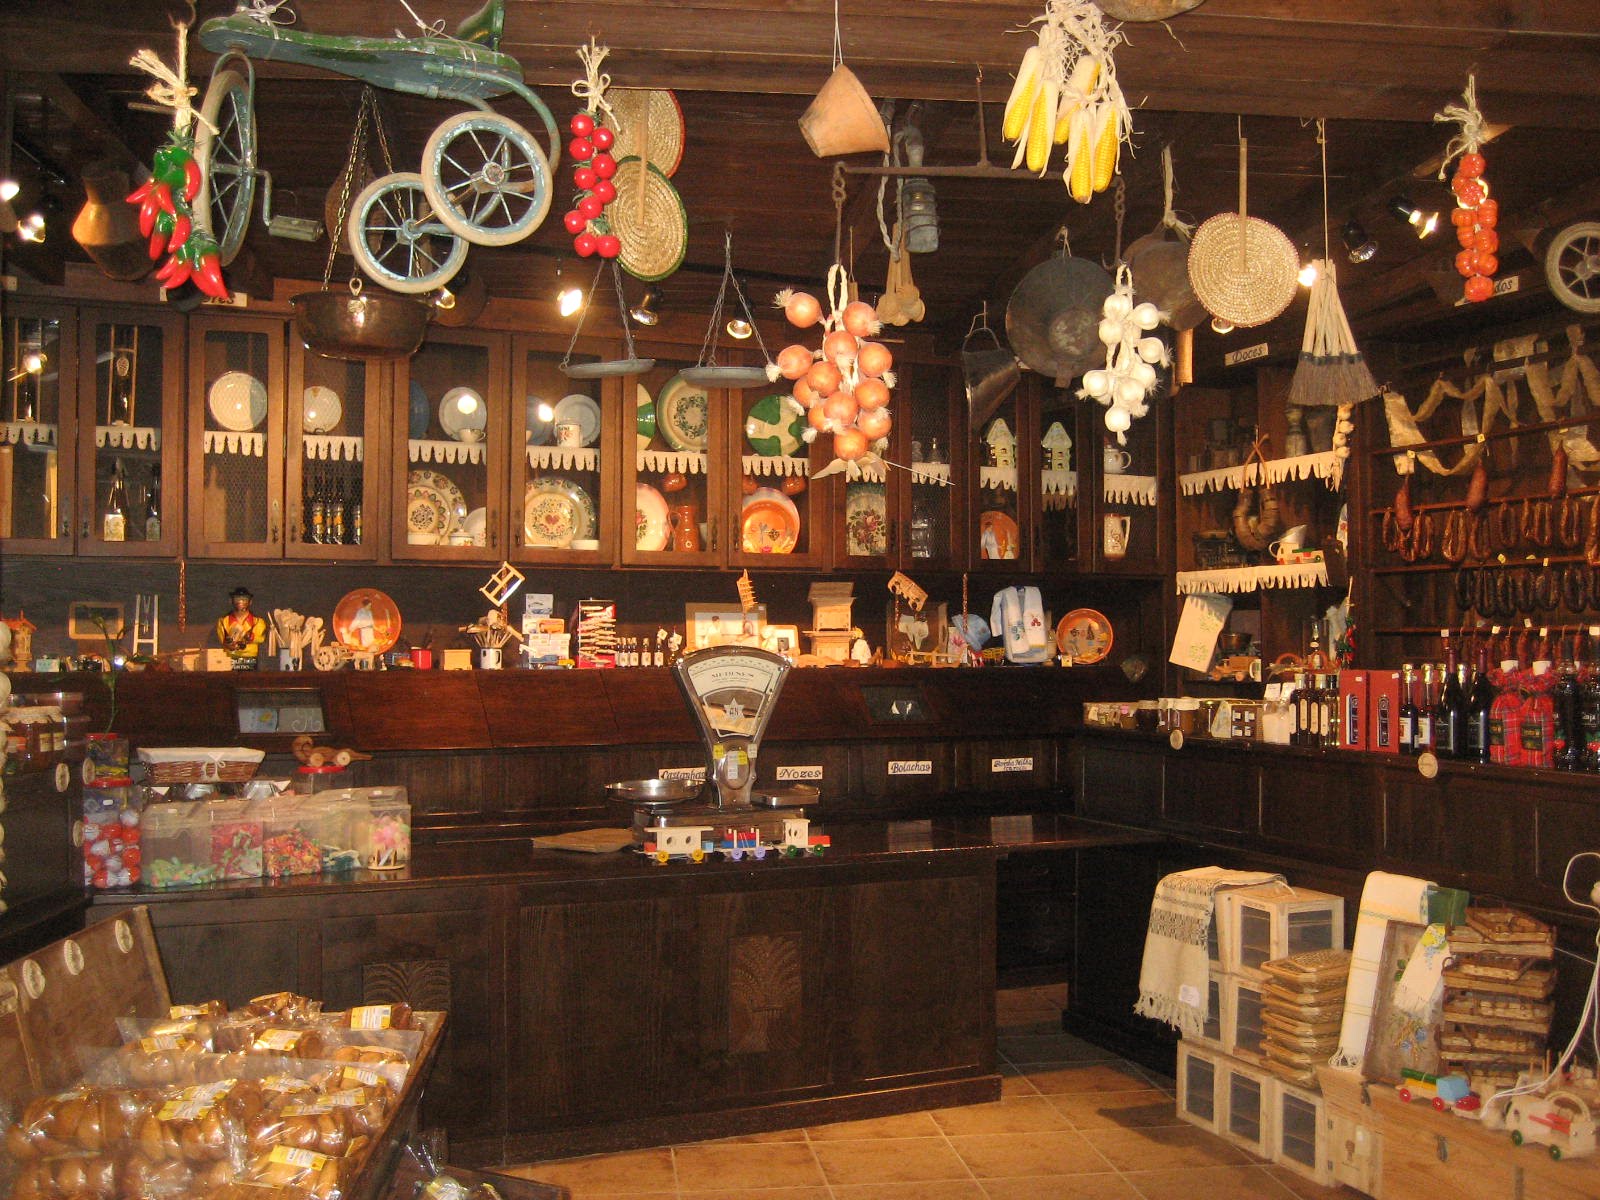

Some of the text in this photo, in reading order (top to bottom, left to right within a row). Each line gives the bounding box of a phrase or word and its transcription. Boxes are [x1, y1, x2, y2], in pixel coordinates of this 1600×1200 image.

[1232, 346, 1263, 362] Doces
[779, 768, 822, 779] Nozes
[891, 762, 931, 774] Bolachas
